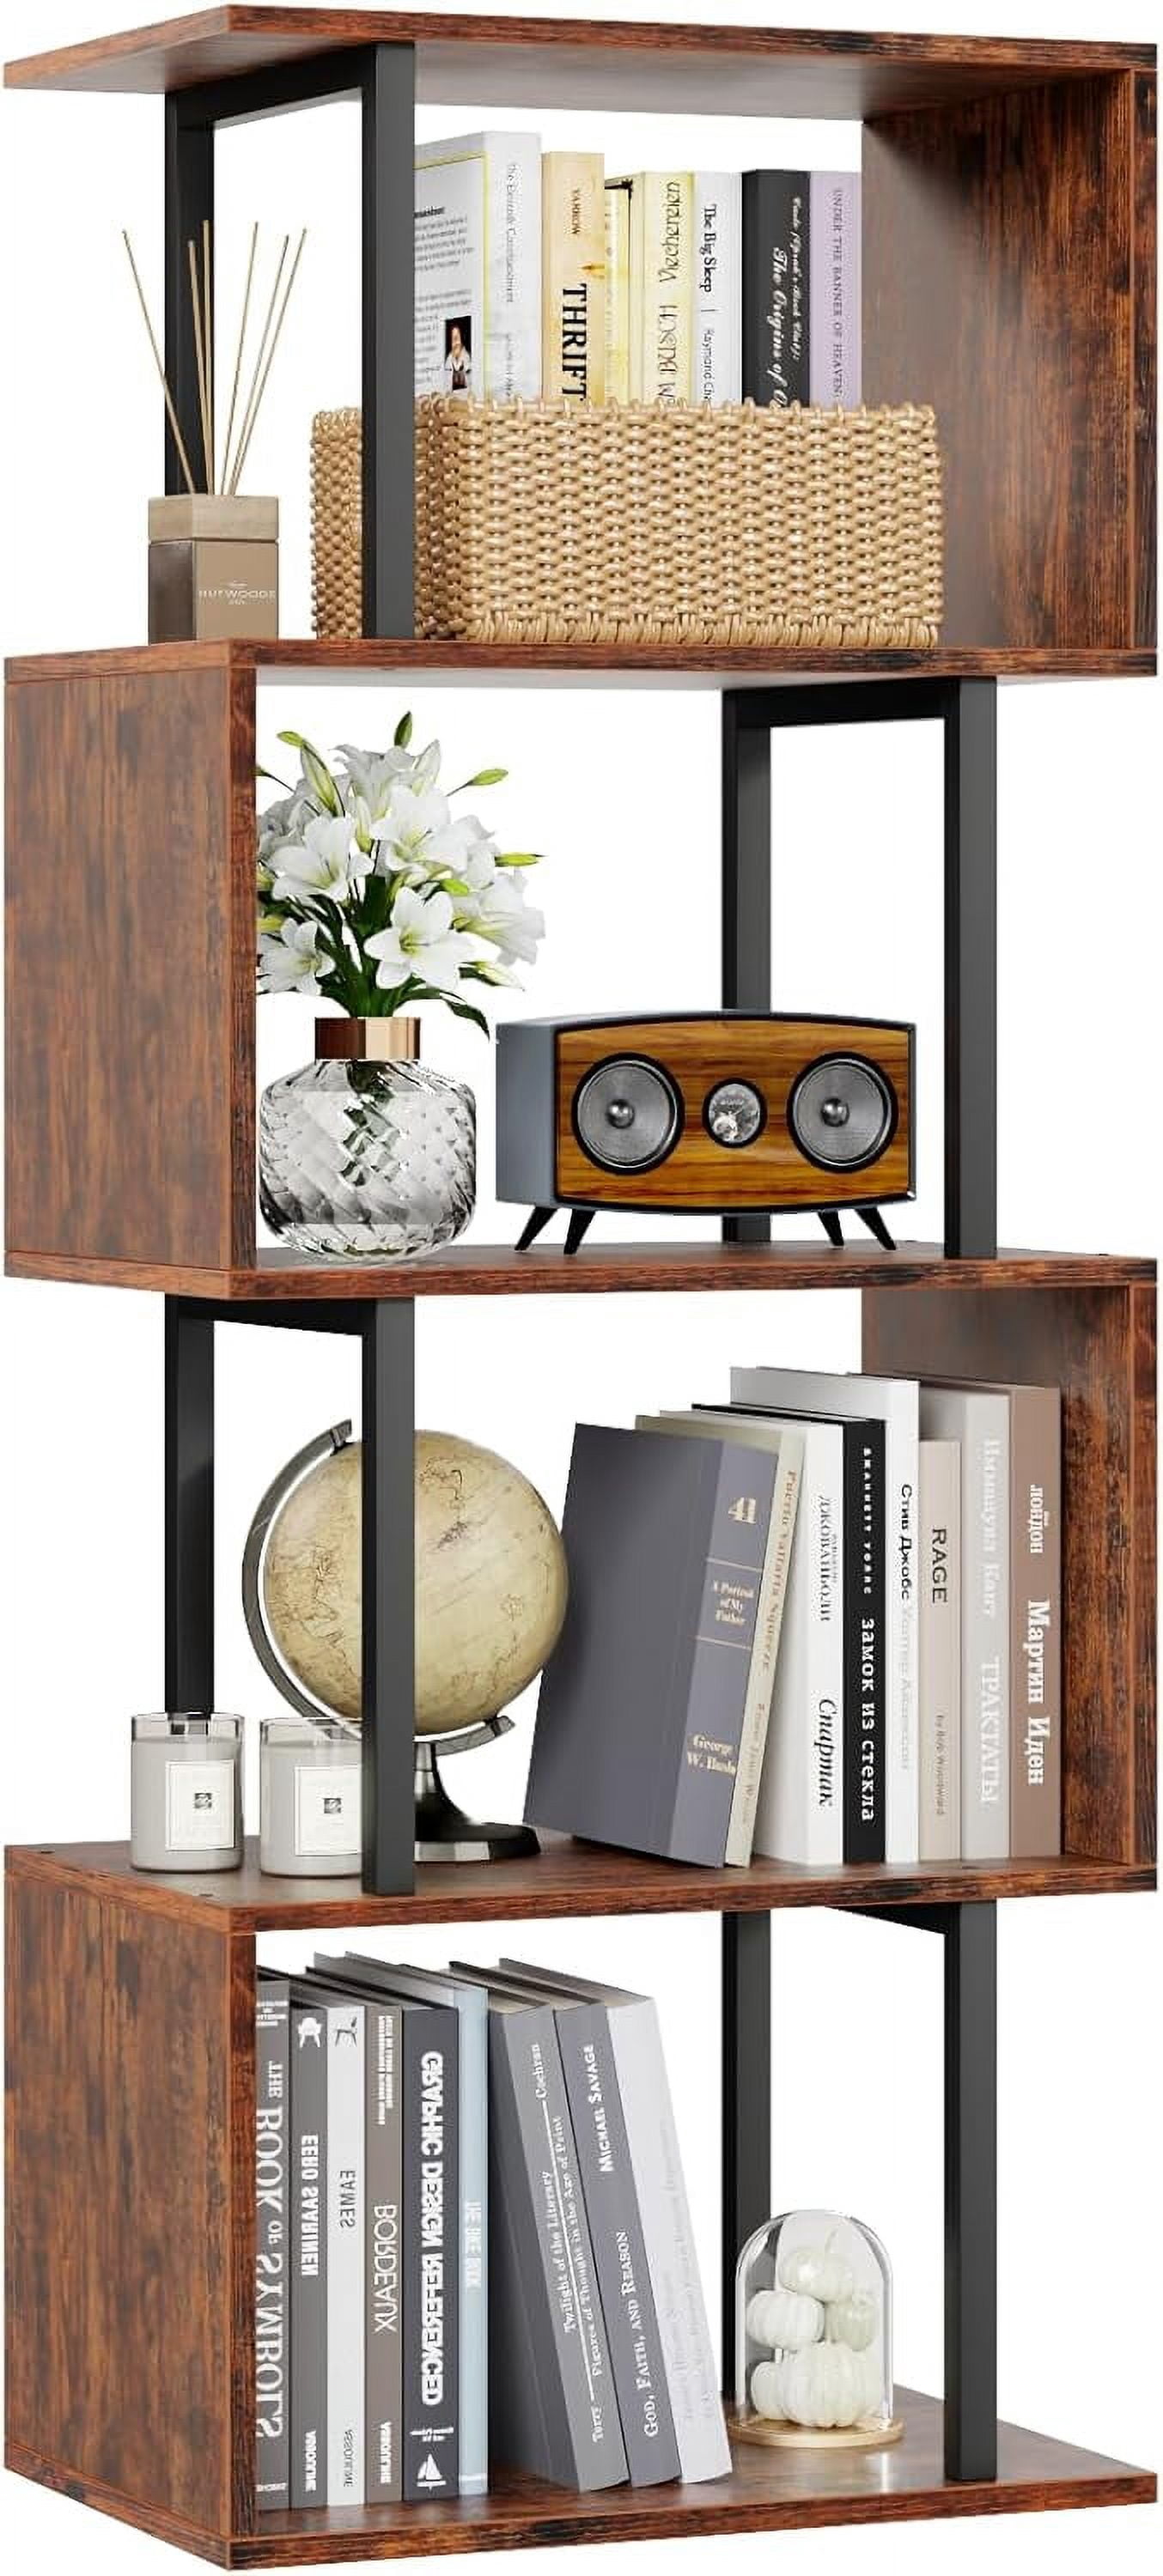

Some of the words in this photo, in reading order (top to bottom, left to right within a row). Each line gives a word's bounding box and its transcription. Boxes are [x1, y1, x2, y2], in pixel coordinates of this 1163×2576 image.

[703, 204, 717, 227] The
[699, 233, 717, 256] Big
[773, 246, 788, 284] The
[831, 236, 843, 261] THE
[699, 257, 718, 294] Sleep
[563, 283, 588, 401] THRIFT
[767, 289, 788, 360] Origins
[728, 1497, 757, 1525] 41
[900, 1484, 913, 1531] Стив
[898, 1535, 913, 1600] Джобс
[932, 1528, 947, 1604] RAGE
[1024, 1600, 1050, 1704] Мартин
[692, 1734, 734, 1757] George
[814, 1698, 837, 1807] Спартак
[980, 1654, 1000, 1801] ТРАКТАТЫ
[1024, 1716, 1050, 1786] Иден
